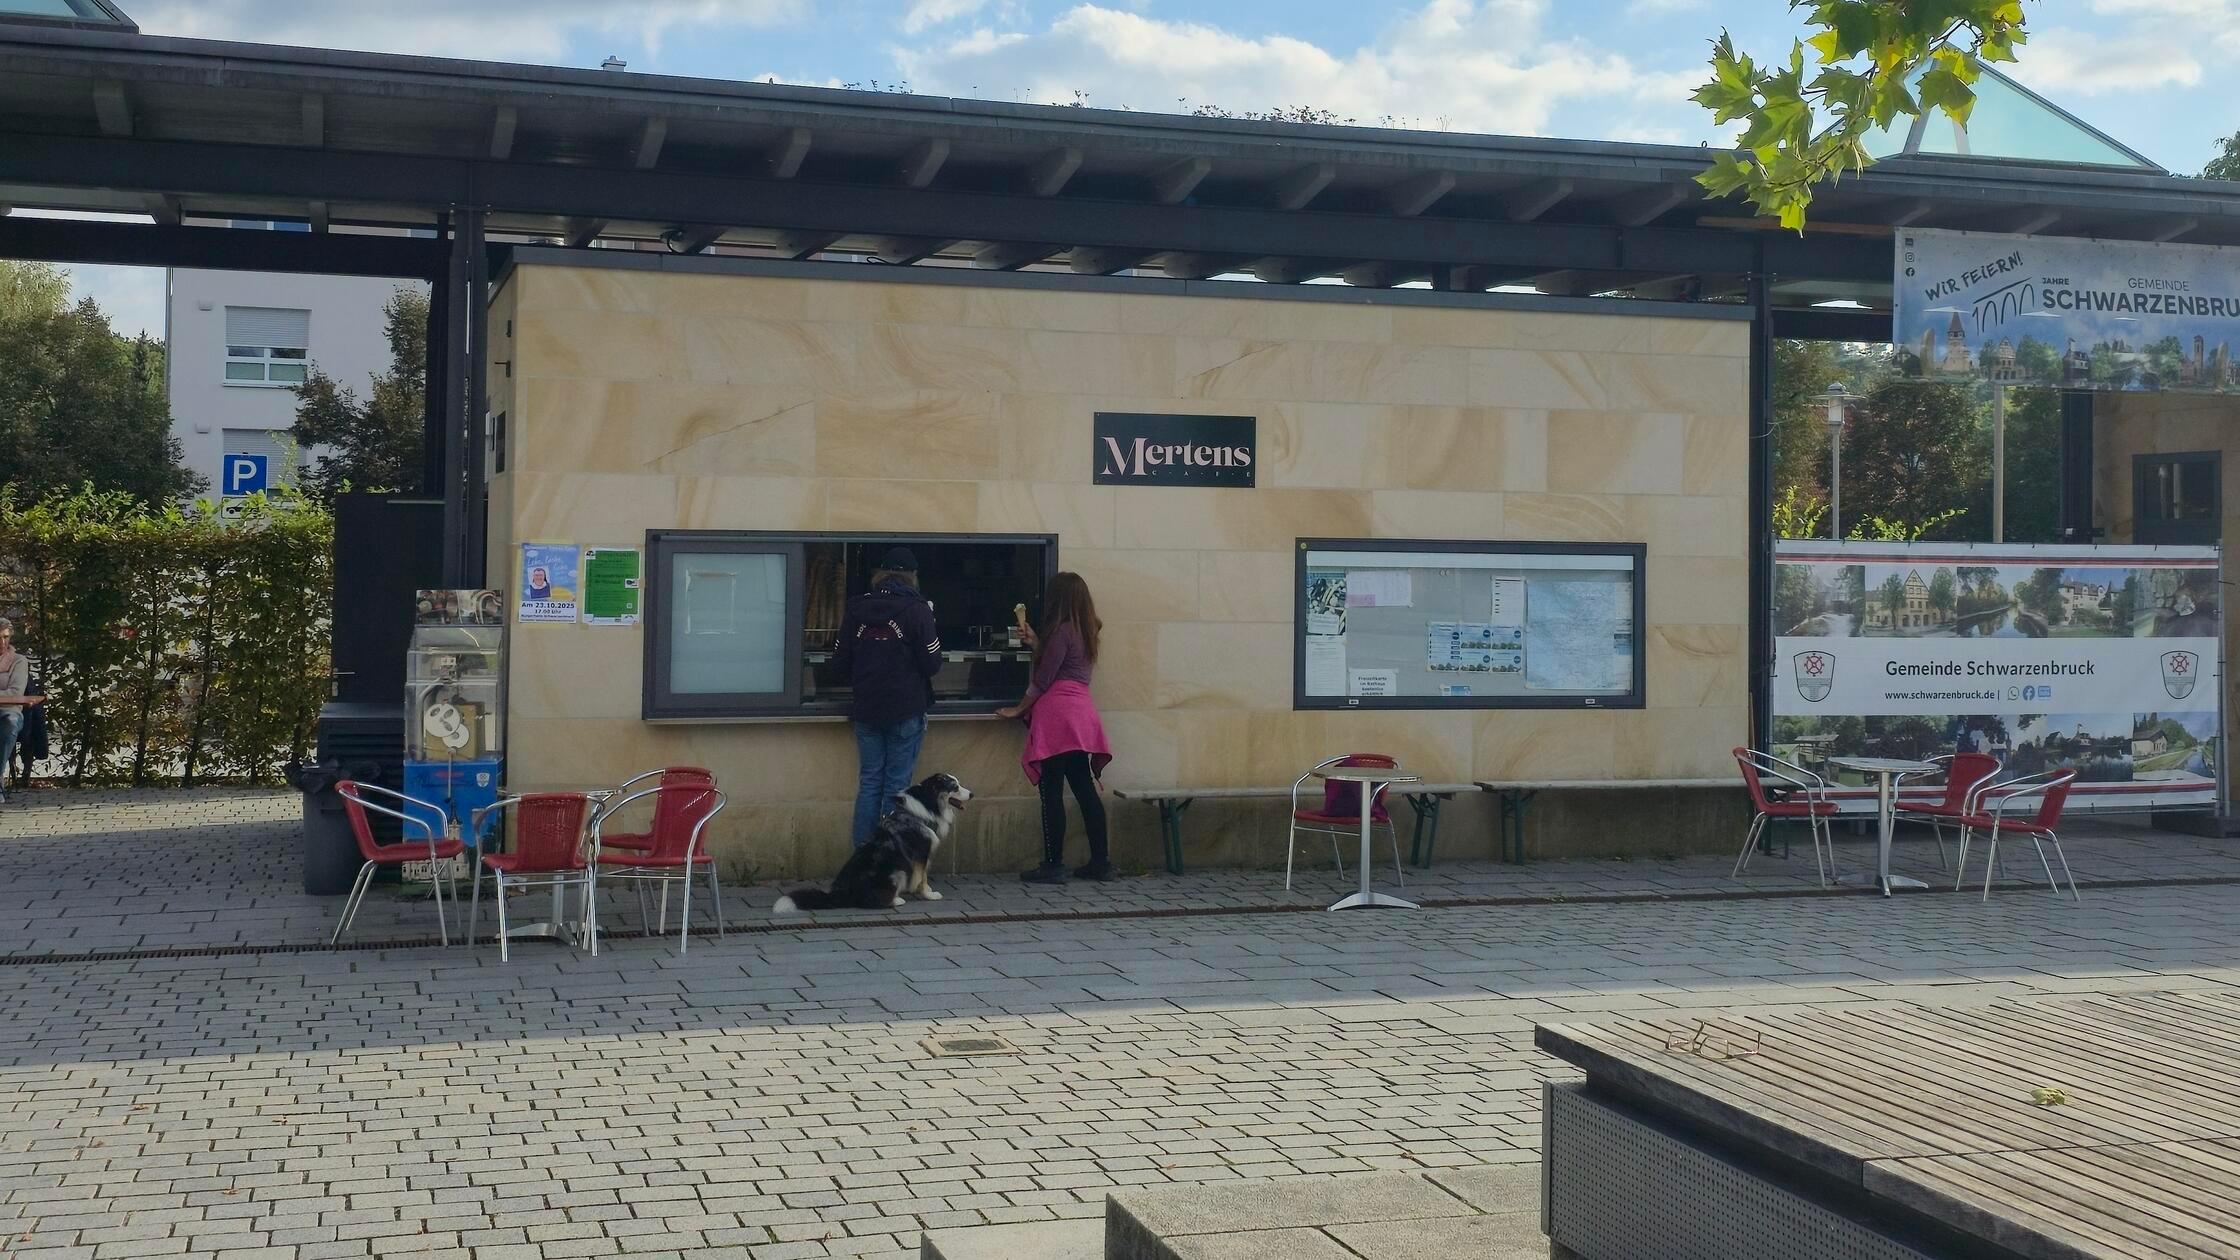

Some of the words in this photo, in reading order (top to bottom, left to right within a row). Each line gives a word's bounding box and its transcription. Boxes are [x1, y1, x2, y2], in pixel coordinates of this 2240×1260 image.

[1925, 278, 1960, 301] WIR
[1961, 251, 2024, 288] FEIERN!
[2041, 276, 2070, 286] JAHRE
[2127, 276, 2191, 292] GEMEINDE
[2041, 288, 2240, 318] SCHWARZENBRU
[1099, 436, 1252, 476] Mertens
[232, 460, 257, 491] P
[1885, 660, 1962, 676] Gemeinde
[1966, 660, 2095, 676] Schwarzenbruck
[1884, 689, 1996, 701] www.schwarzenbruck.de
